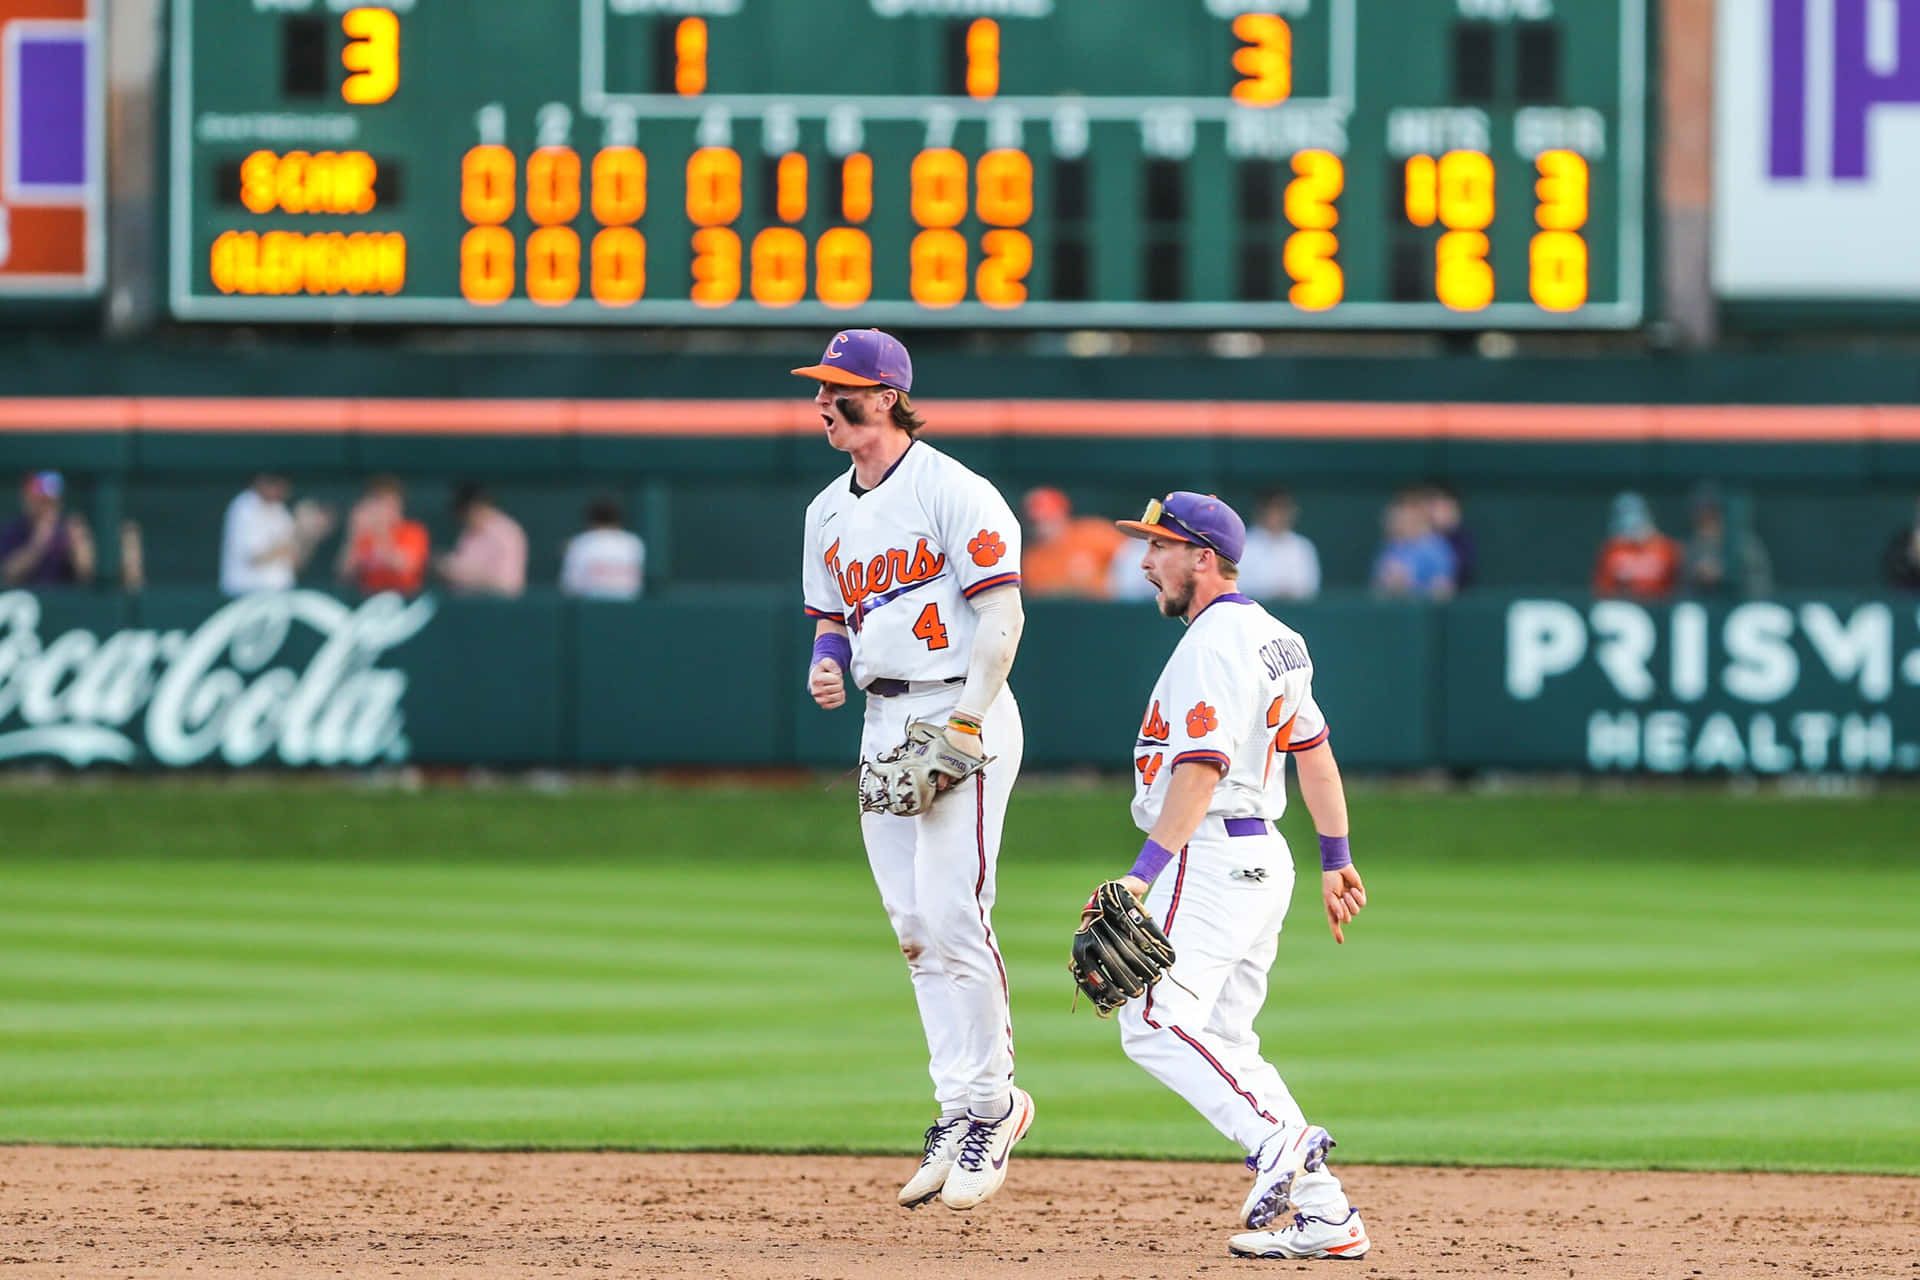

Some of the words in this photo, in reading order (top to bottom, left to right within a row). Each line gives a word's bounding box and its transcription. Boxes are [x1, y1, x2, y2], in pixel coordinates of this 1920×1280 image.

[341, 7, 400, 105] 3
[1231, 12, 1292, 109] 3
[461, 145, 516, 225] 0
[525, 146, 581, 226] 0
[591, 146, 647, 226] 0
[685, 147, 742, 227] 0
[910, 147, 968, 228] 0
[975, 148, 1033, 226] 0
[1284, 149, 1344, 230] 2
[1405, 150, 1495, 230] 10
[1535, 149, 1589, 230] 3
[460, 225, 515, 306] 0
[525, 225, 581, 307] 0
[590, 225, 646, 307] 0
[691, 226, 742, 308] 3
[751, 227, 807, 308] 0
[815, 227, 872, 308] 0
[910, 228, 968, 308] 0
[975, 229, 1033, 309] 2
[1283, 229, 1344, 311] 5
[1435, 230, 1495, 311] 6
[1529, 230, 1588, 311] 0
[824, 536, 945, 631] Tigers
[912, 602, 949, 651] 4
